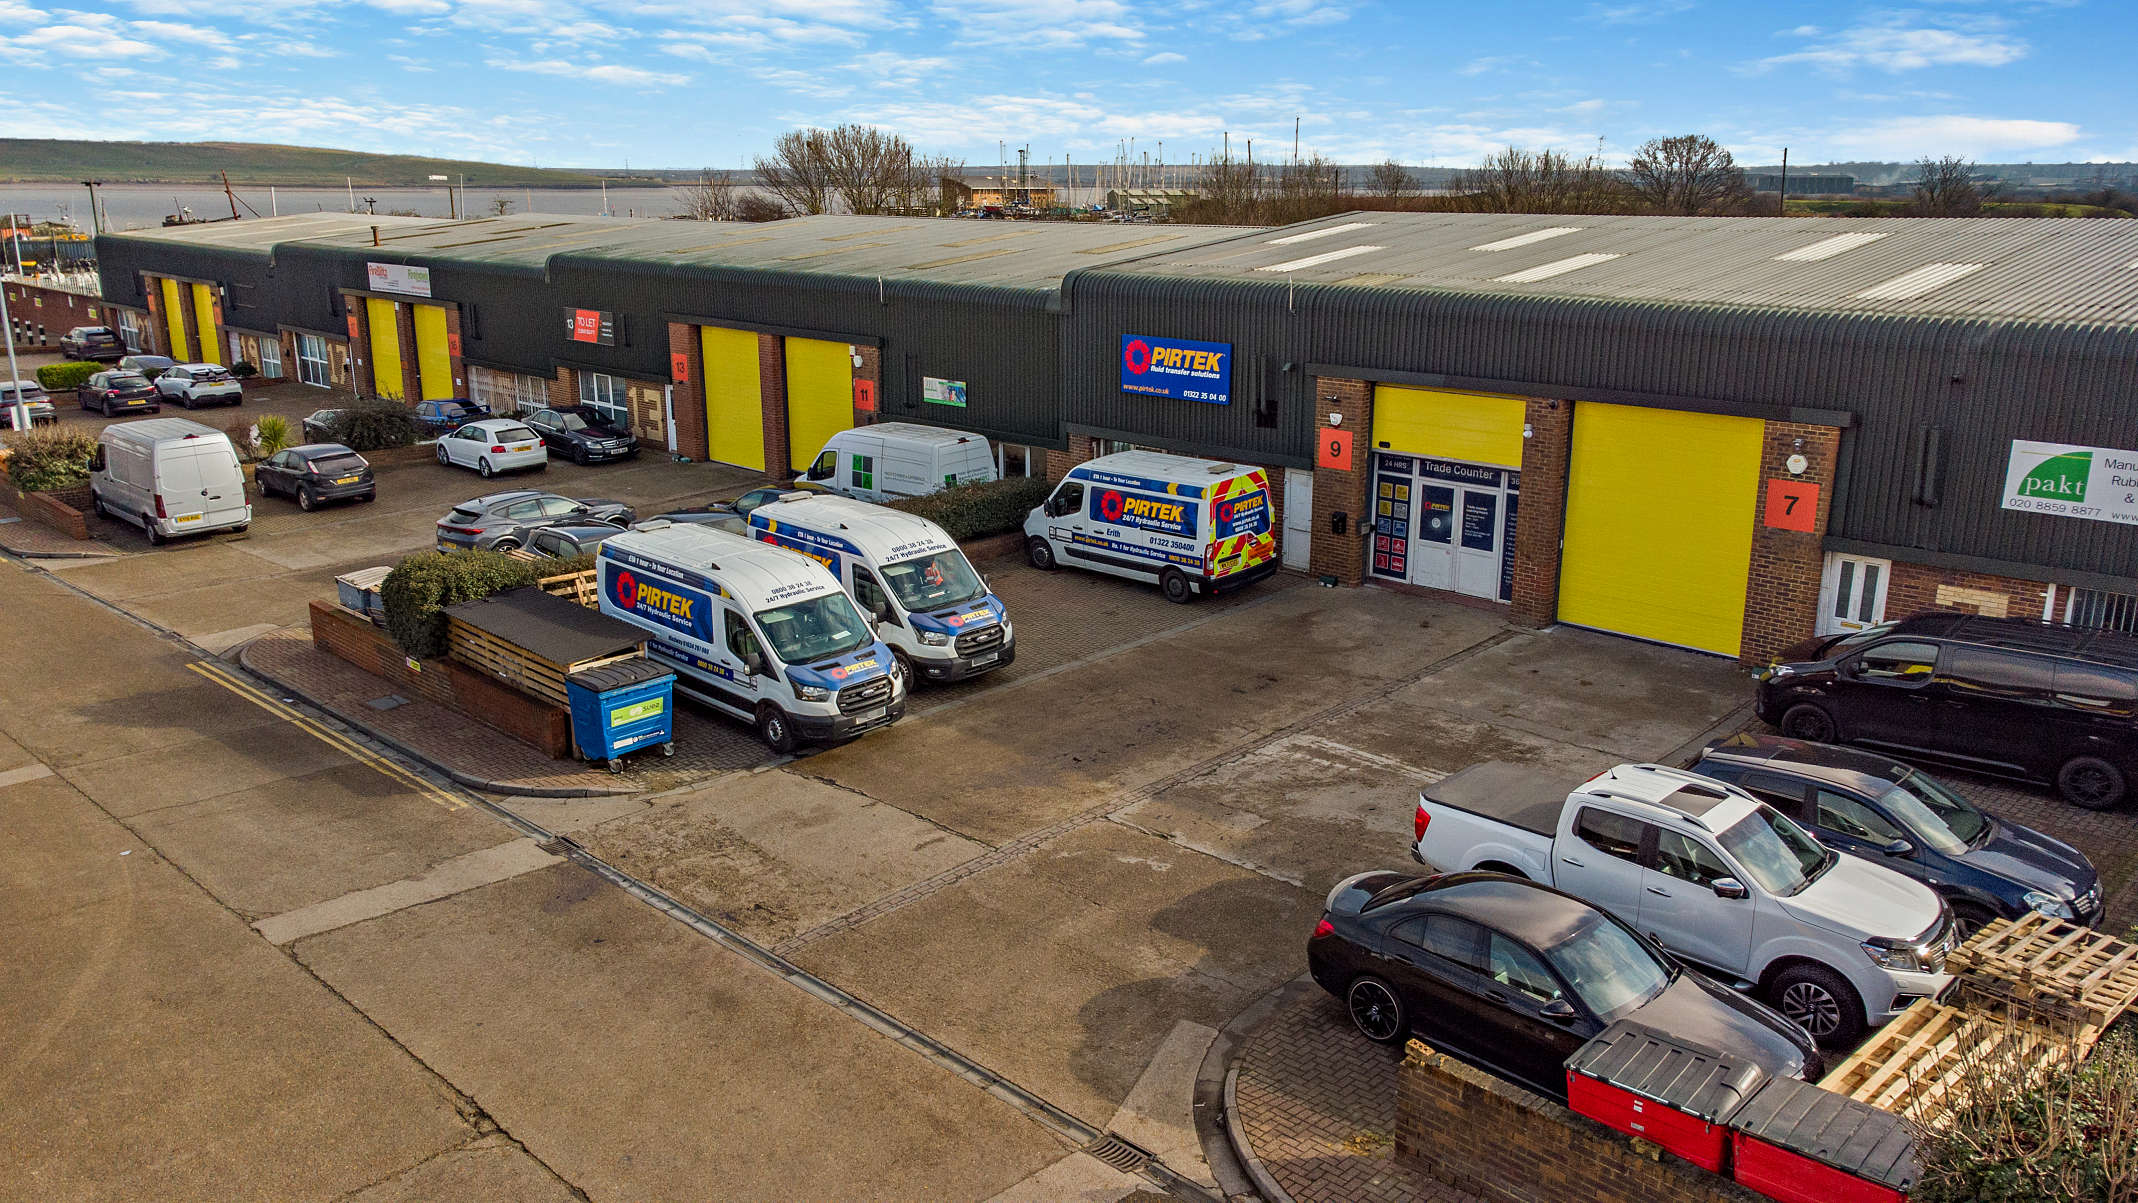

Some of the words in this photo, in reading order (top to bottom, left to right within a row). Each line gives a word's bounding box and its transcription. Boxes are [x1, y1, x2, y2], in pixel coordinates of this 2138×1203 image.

[567, 318, 574, 329] 13
[577, 317, 585, 326] TO
[586, 318, 596, 327] LET
[326, 343, 347, 384] 17
[1151, 346, 1223, 372] PIRTEK
[676, 362, 685, 374] 13
[1165, 366, 1190, 376] transfer
[1191, 371, 1220, 379] solutions
[860, 389, 868, 400] 11
[1123, 384, 1170, 395] www.pirtek.co.uk
[1184, 390, 1199, 398] 01322
[628, 386, 664, 442] 13
[1330, 440, 1341, 457] 9
[1425, 460, 1451, 473] Trade
[1454, 465, 1494, 480] Counter
[2024, 475, 2087, 495] pakt
[2112, 475, 2138, 487] Rub
[1234, 494, 1264, 513] PIRTEK
[1784, 495, 1799, 515] 7
[2124, 493, 2134, 504] &
[1123, 497, 1184, 522] PIRTEK
[2009, 498, 2032, 508] 020
[2036, 501, 2066, 512] 8859
[2071, 506, 2102, 517] 8877
[1136, 516, 1160, 526] Hydraulic
[1161, 521, 1182, 530] Service
[1106, 528, 1120, 538] Erith
[1150, 537, 1169, 547] 01322
[1170, 541, 1195, 552] 350400
[900, 547, 927, 557] Hydraulic
[637, 582, 694, 619] PIRTEK
[636, 602, 647, 610] 24/7
[648, 606, 671, 620] Hydraulic
[672, 615, 692, 627] Service
[961, 609, 990, 620] PIRTEK
[845, 659, 877, 672] PIRTEK
